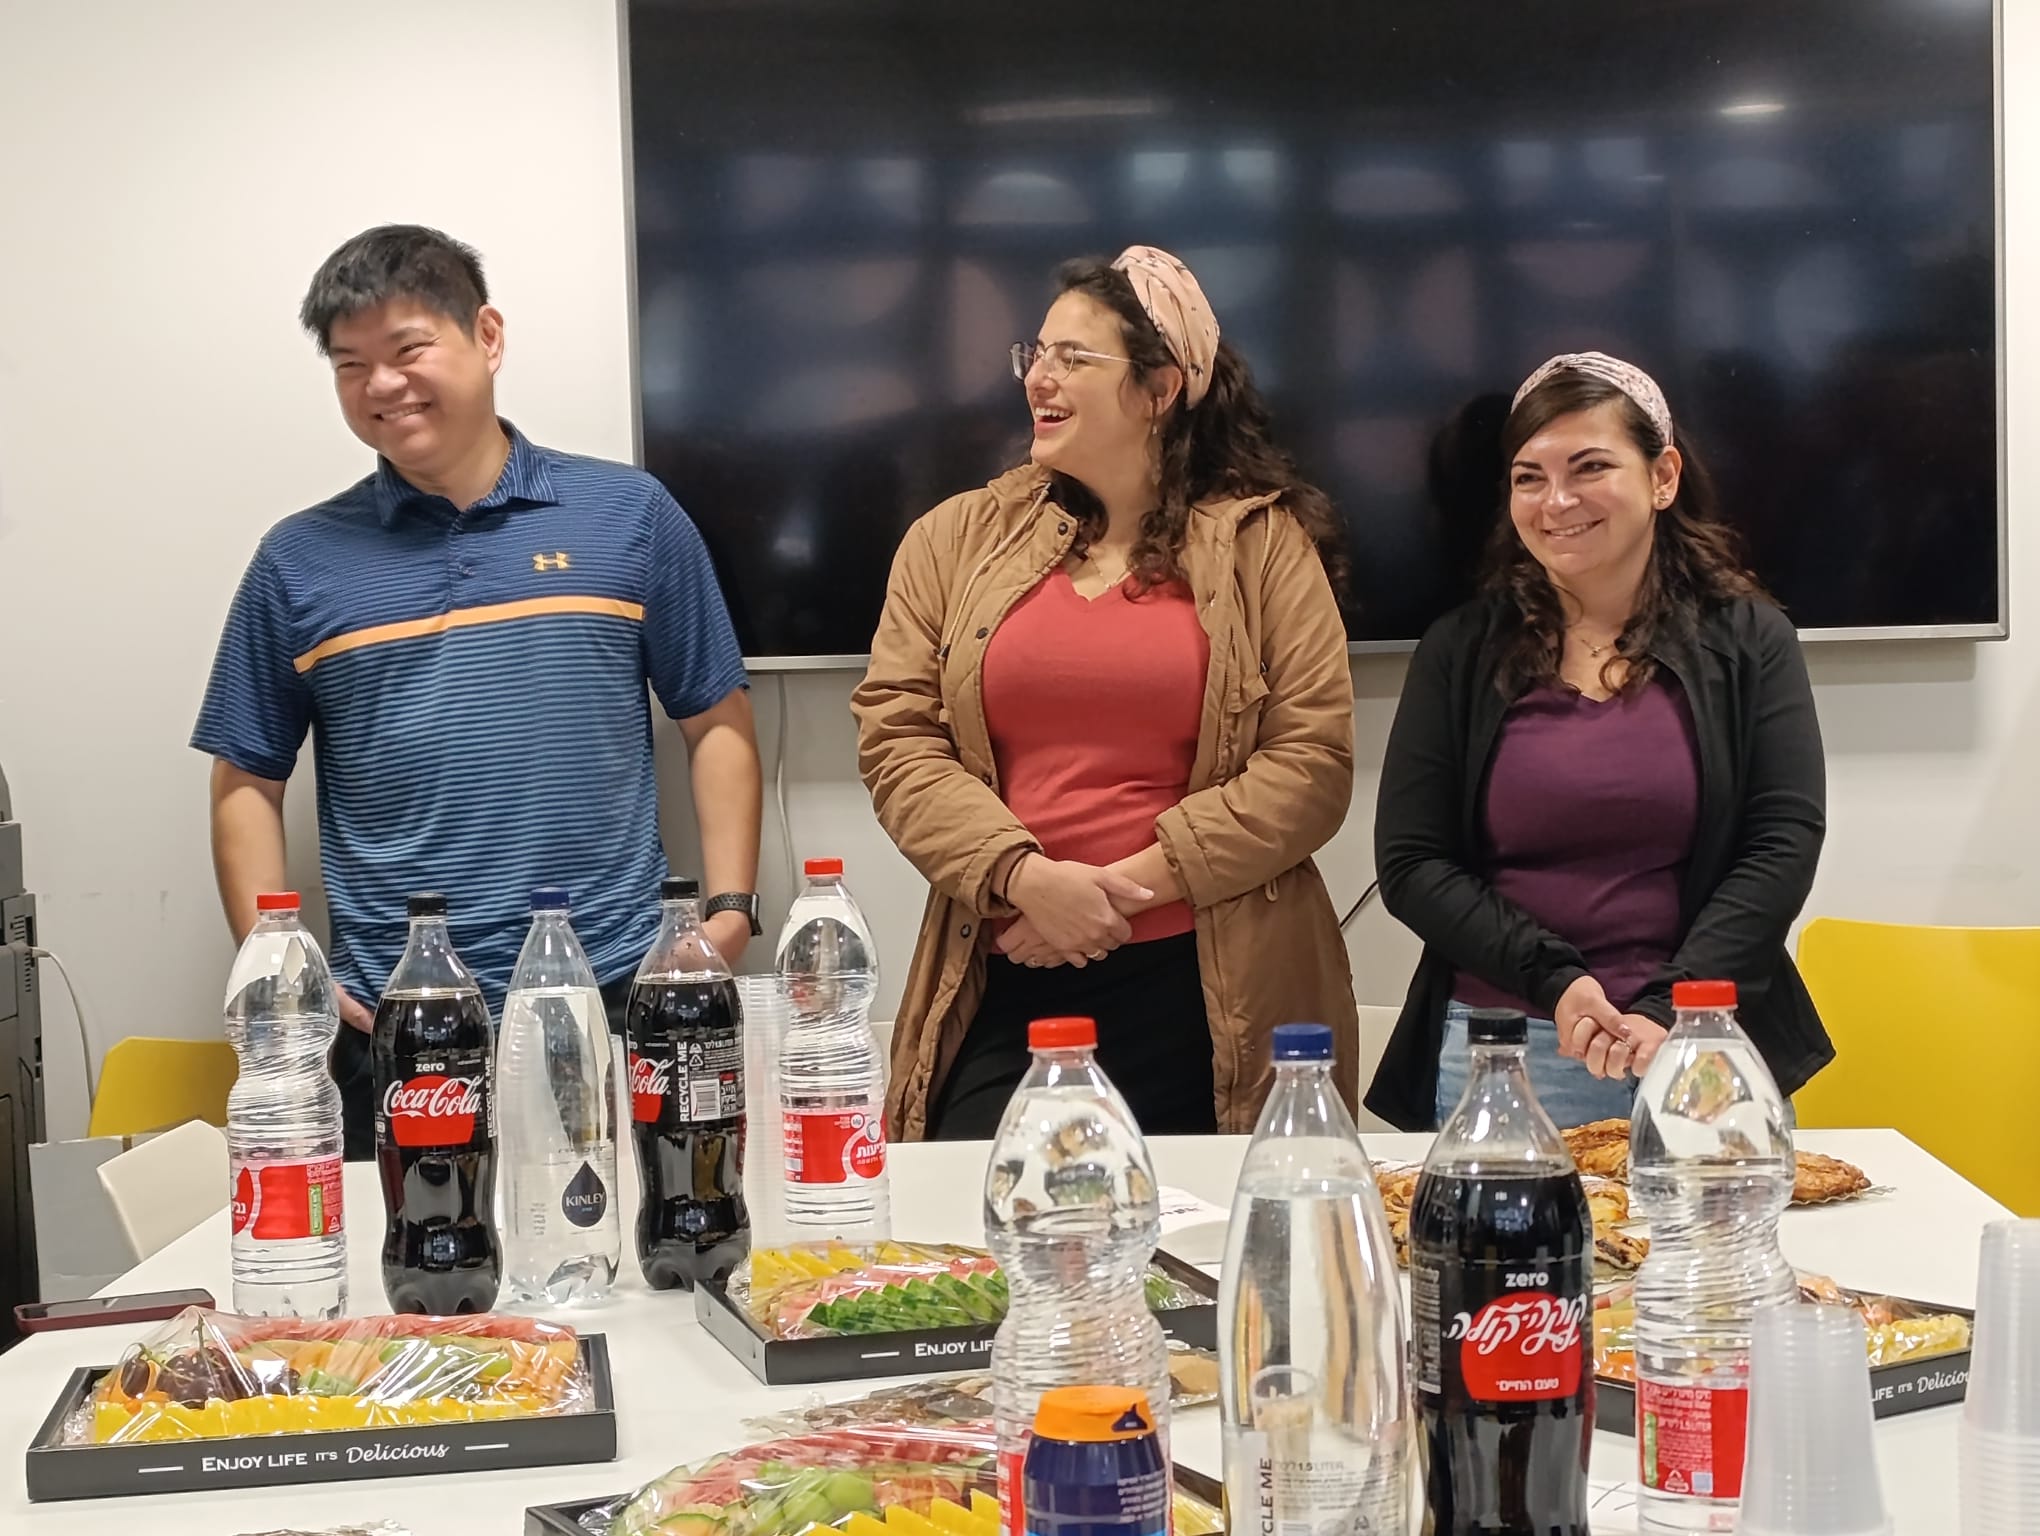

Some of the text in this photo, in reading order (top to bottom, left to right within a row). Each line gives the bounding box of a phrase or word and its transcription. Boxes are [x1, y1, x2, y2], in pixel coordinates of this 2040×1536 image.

[415, 1062, 446, 1073] zero
[677, 1041, 690, 1121] RECYCLE ME
[383, 1074, 484, 1118] Coca-Cola
[565, 1191, 605, 1207] KINLEY
[1505, 1271, 1549, 1288] zero
[914, 1339, 995, 1358] ENJOY LIF
[201, 1456, 264, 1472] ENJOY
[268, 1452, 308, 1468] LIFE
[345, 1443, 451, 1464] Delicious
[1260, 1458, 1273, 1489] ME
